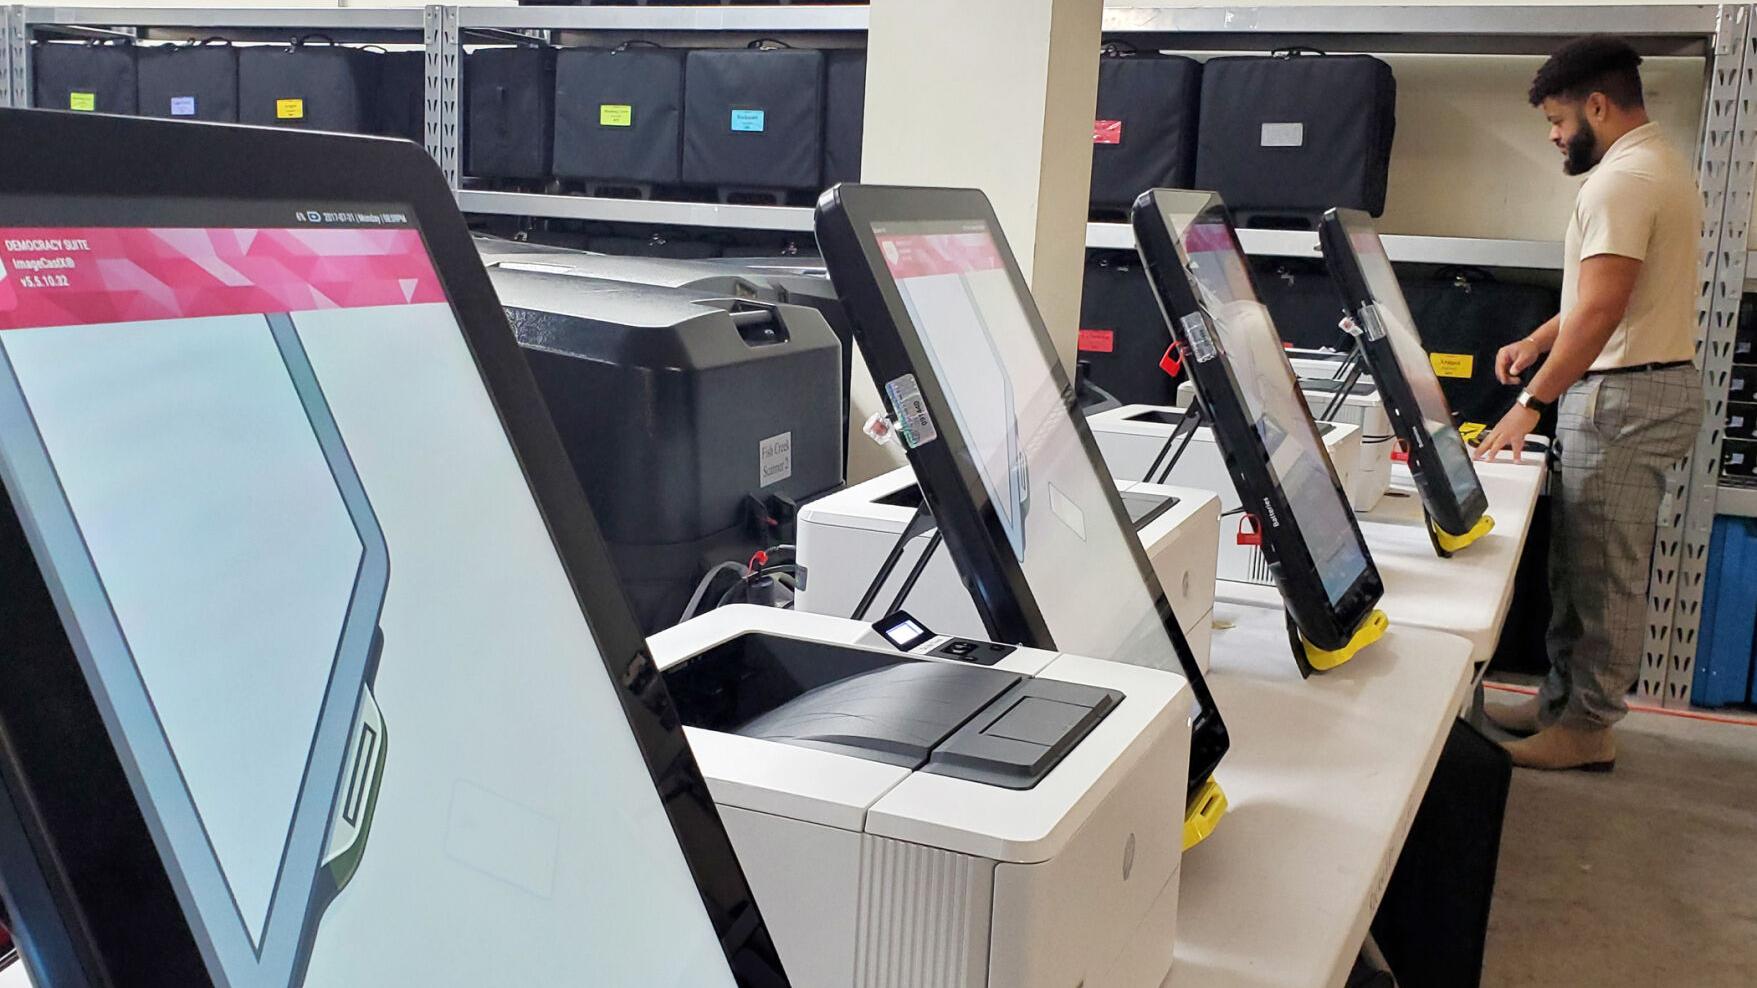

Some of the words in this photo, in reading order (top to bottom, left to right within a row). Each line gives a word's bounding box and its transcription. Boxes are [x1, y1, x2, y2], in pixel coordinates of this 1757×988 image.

[4, 239, 63, 252] DEMOCRACY
[63, 239, 91, 251] SUITE
[1263, 497, 1280, 528] Batteries
